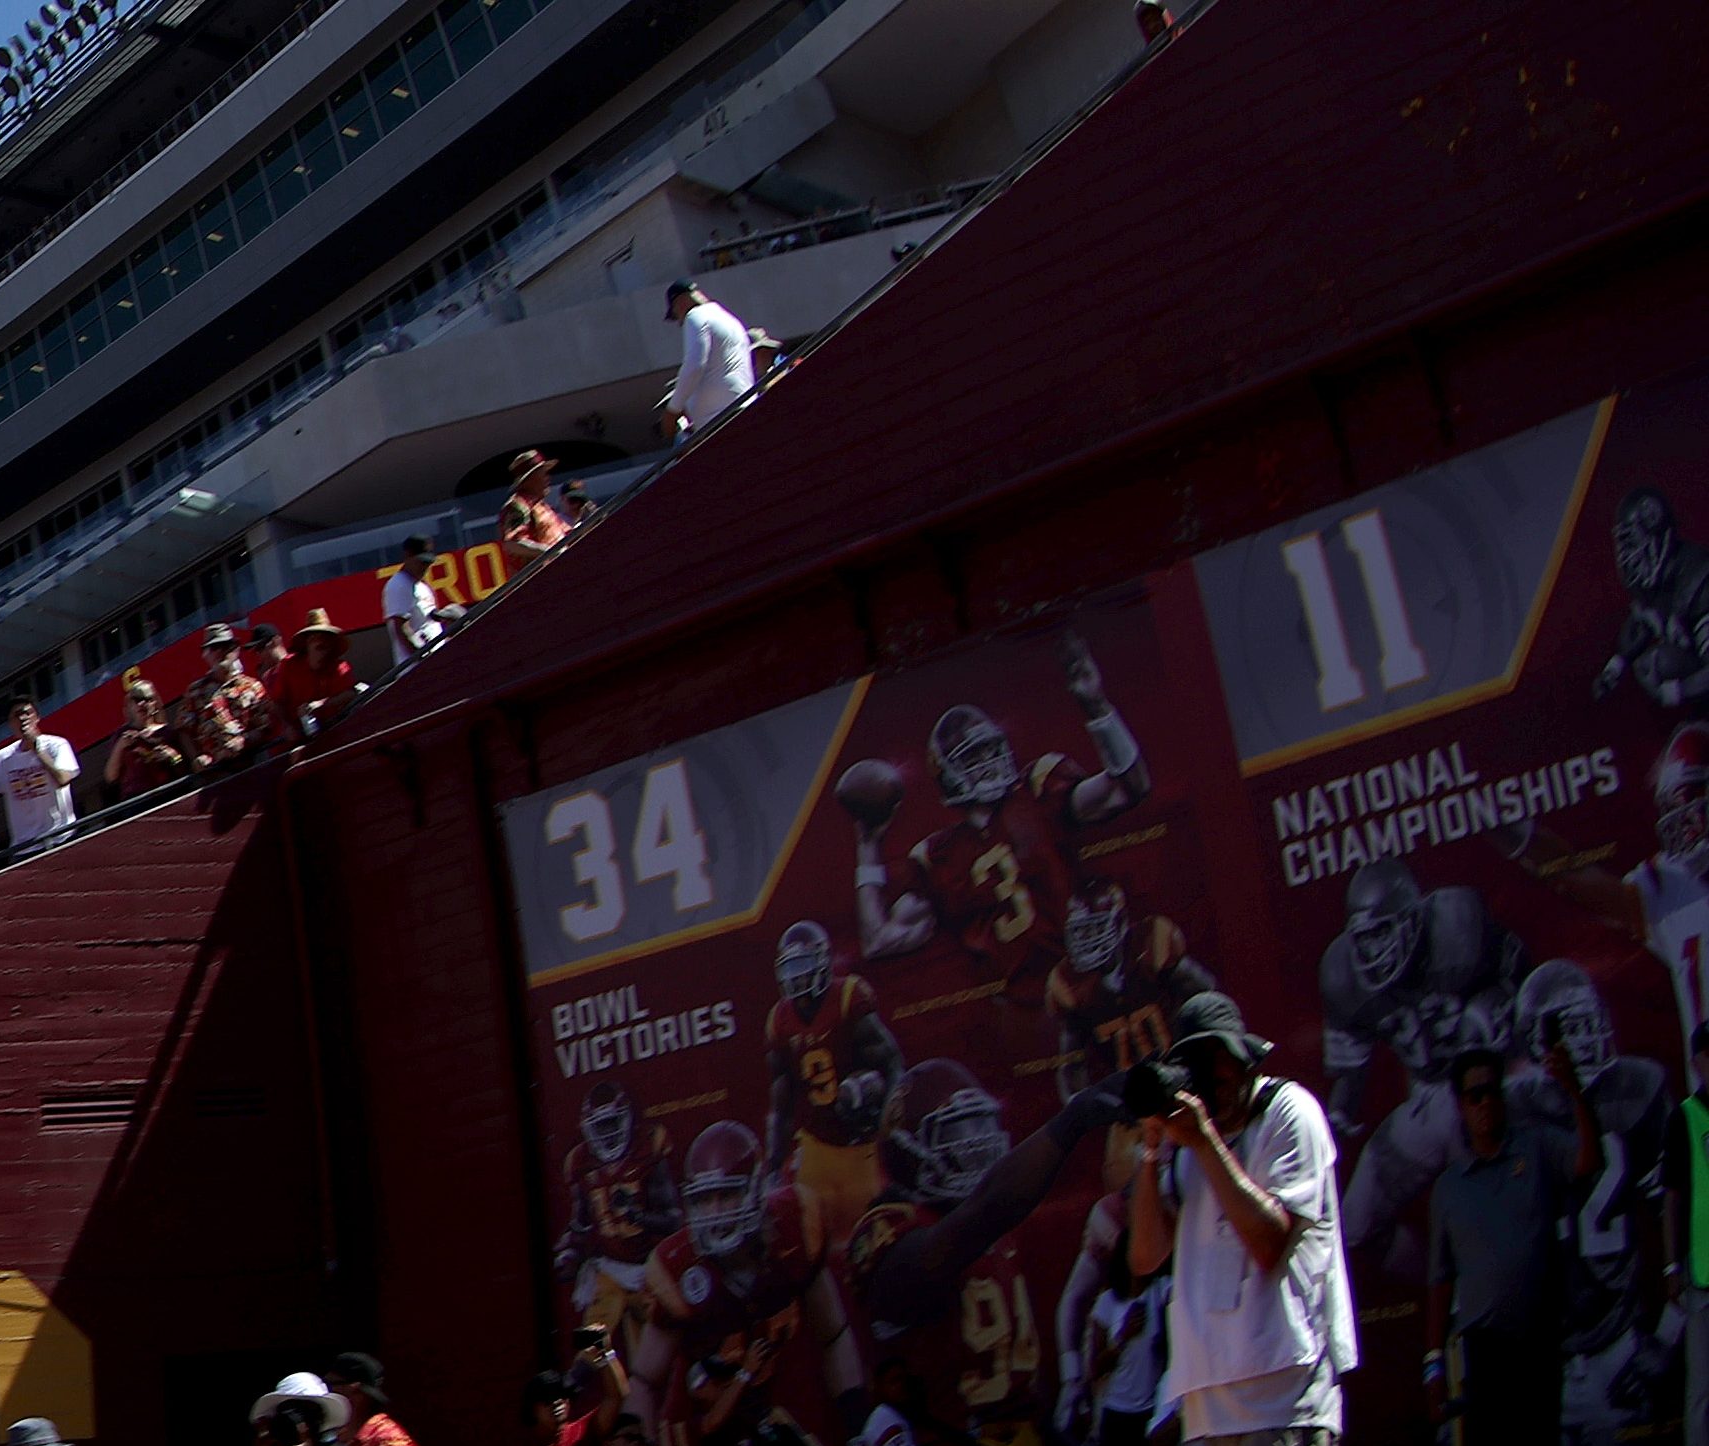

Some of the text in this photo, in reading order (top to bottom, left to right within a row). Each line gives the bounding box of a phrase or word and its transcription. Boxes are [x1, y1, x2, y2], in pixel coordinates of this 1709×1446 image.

[1282, 507, 1429, 713] 11
[1271, 741, 1479, 841] NATIONAL
[1281, 745, 1620, 888] CHAMPIONSHIPS
[545, 756, 713, 943] 34
[969, 841, 1036, 944] 3
[550, 984, 651, 1042] BOWL
[554, 1000, 737, 1080] VICTORIES
[799, 1047, 838, 1107] 9
